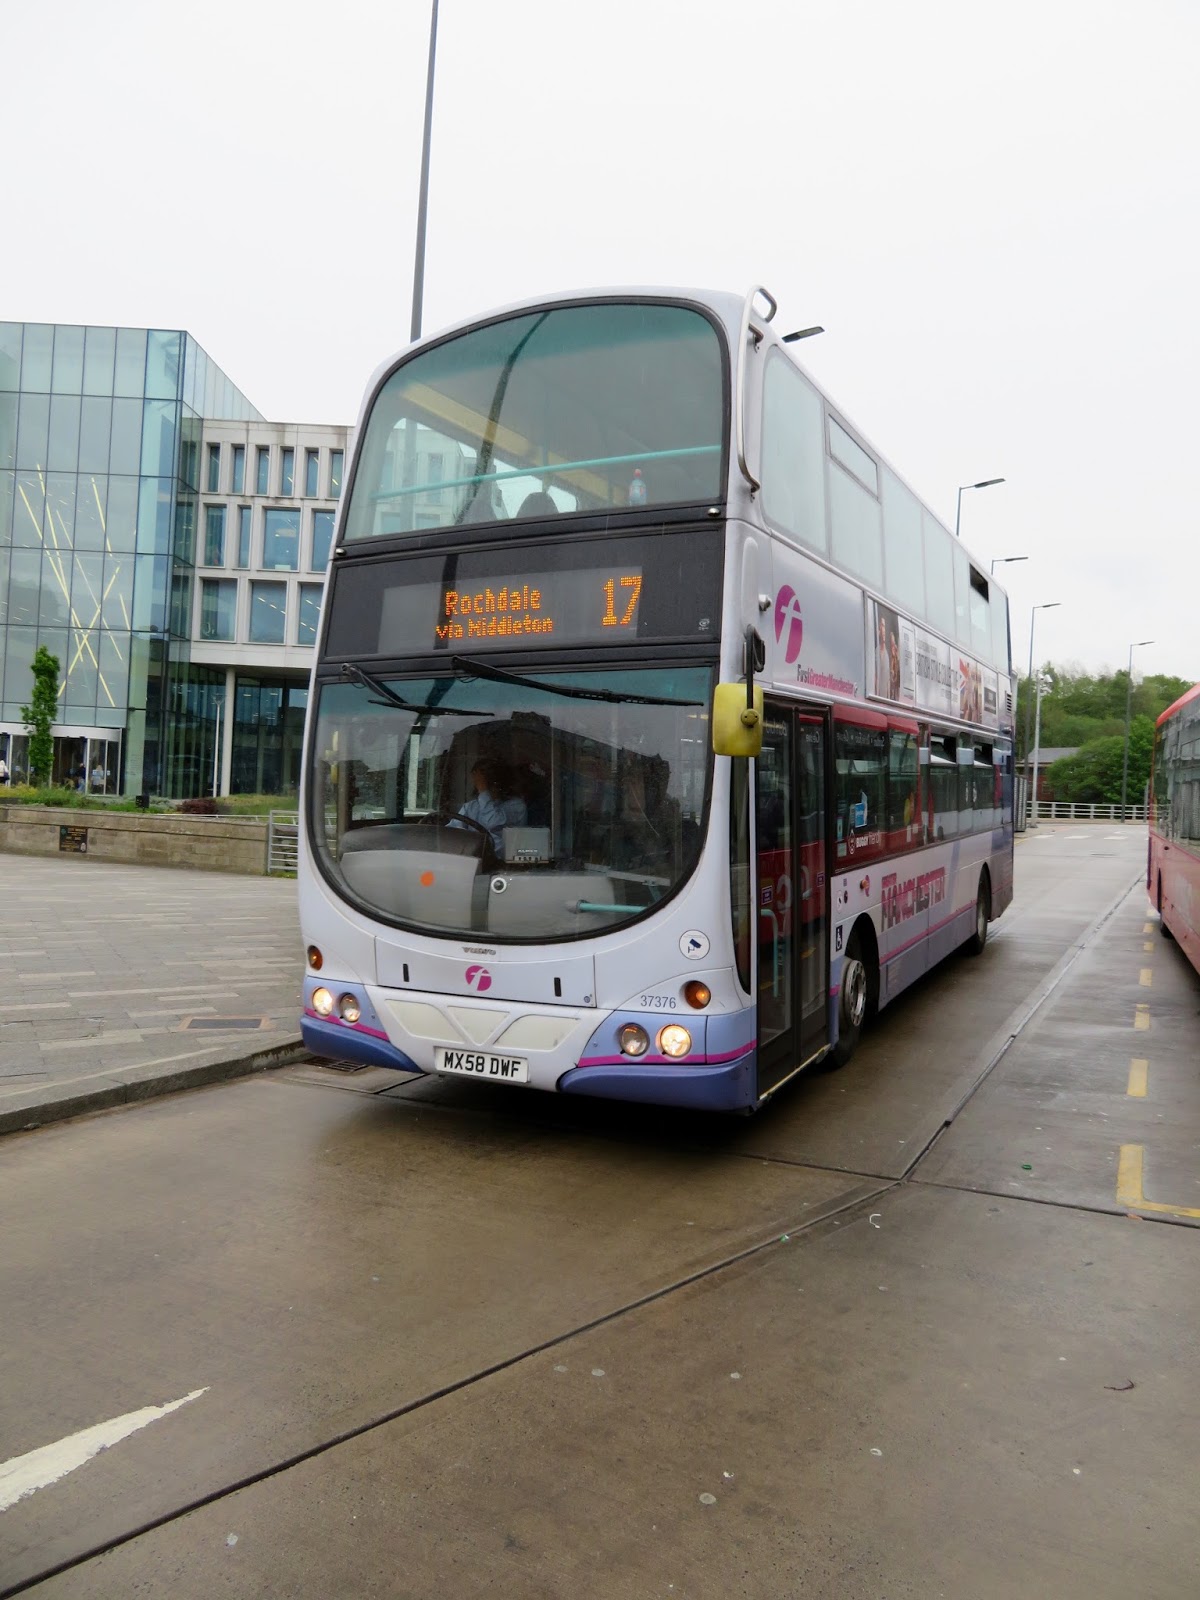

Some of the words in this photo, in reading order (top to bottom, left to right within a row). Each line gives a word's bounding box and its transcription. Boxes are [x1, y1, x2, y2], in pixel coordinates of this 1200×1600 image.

[445, 585, 541, 616] Rochdale
[602, 575, 643, 627] 17
[435, 619, 463, 639] via
[468, 614, 554, 637] Middleton
[640, 994, 677, 1010] 37376
[444, 1051, 485, 1072] MX58
[490, 1056, 521, 1078] DWF
